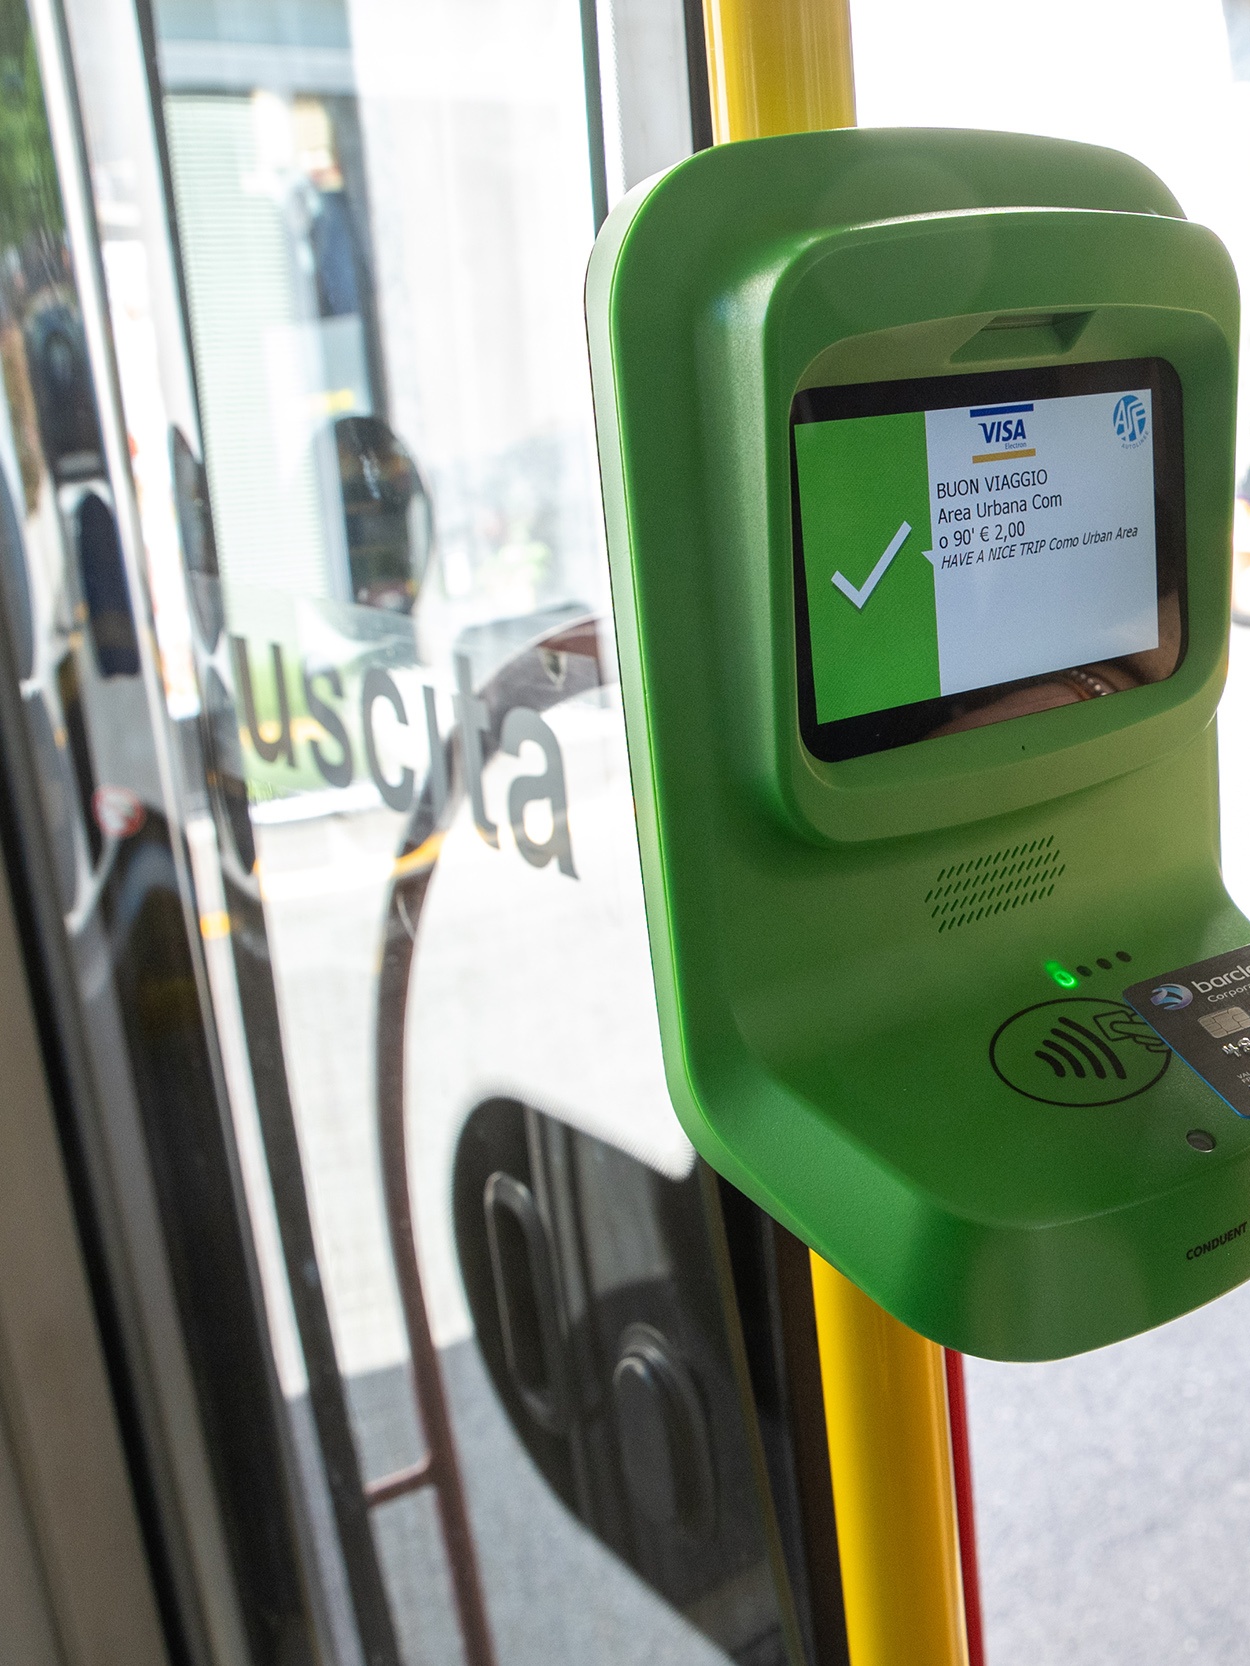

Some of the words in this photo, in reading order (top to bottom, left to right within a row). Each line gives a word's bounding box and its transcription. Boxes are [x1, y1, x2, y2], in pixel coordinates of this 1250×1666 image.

[977, 418, 1027, 444] VISA
[1004, 441, 1027, 450] Electron
[936, 478, 980, 499] BUON
[984, 468, 1048, 492] VIAGGIO
[938, 506, 971, 525] Area
[976, 497, 1028, 518] Urbana
[1032, 493, 1063, 510] Com
[940, 551, 975, 570] HAVE
[975, 549, 985, 564] A
[987, 544, 1016, 562] NICE
[1019, 539, 1046, 556] TRIP
[1049, 534, 1080, 551] Como
[1082, 529, 1114, 546] Urban
[1114, 525, 1139, 541] Area
[953, 527, 975, 547] 90'
[979, 526, 990, 542] €
[994, 520, 1026, 543] 2,00
[229, 635, 580, 881] uscita
[1185, 1221, 1248, 1261] CONDUENT
